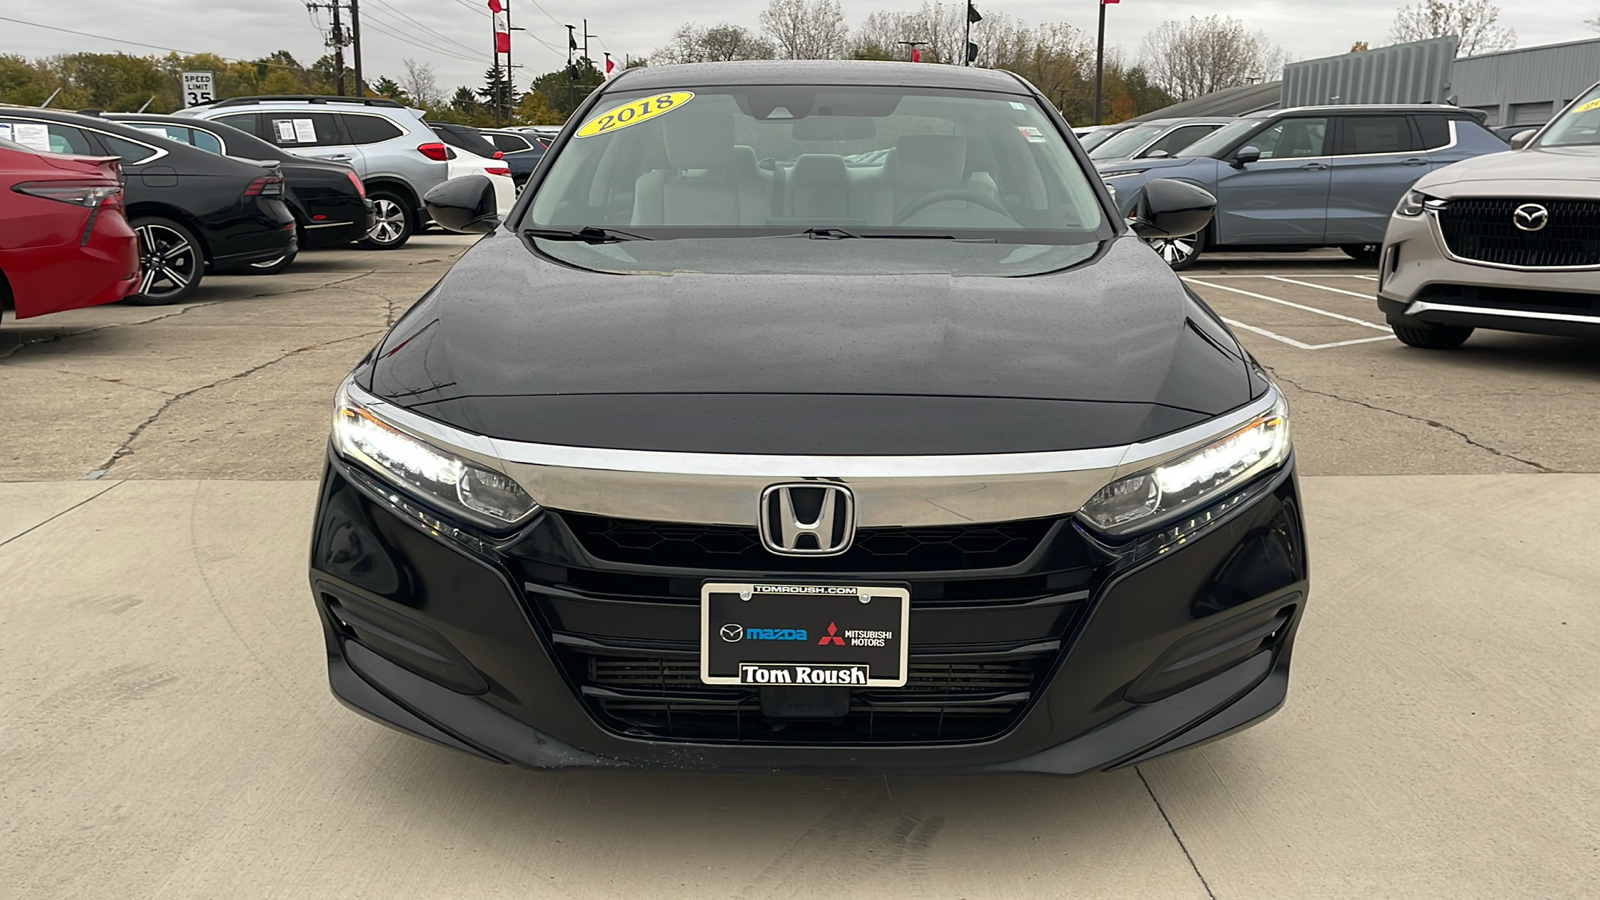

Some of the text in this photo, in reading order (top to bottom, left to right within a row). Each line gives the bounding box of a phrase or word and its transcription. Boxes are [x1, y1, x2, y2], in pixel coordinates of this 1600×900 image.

[187, 92, 211, 106] 35
[598, 95, 674, 132] 2018
[754, 585, 857, 594] TOMROUSH.COM
[844, 630, 893, 640] MITSUBISHI
[851, 638, 886, 647] MOTORS
[742, 666, 867, 685] Tom Roush
